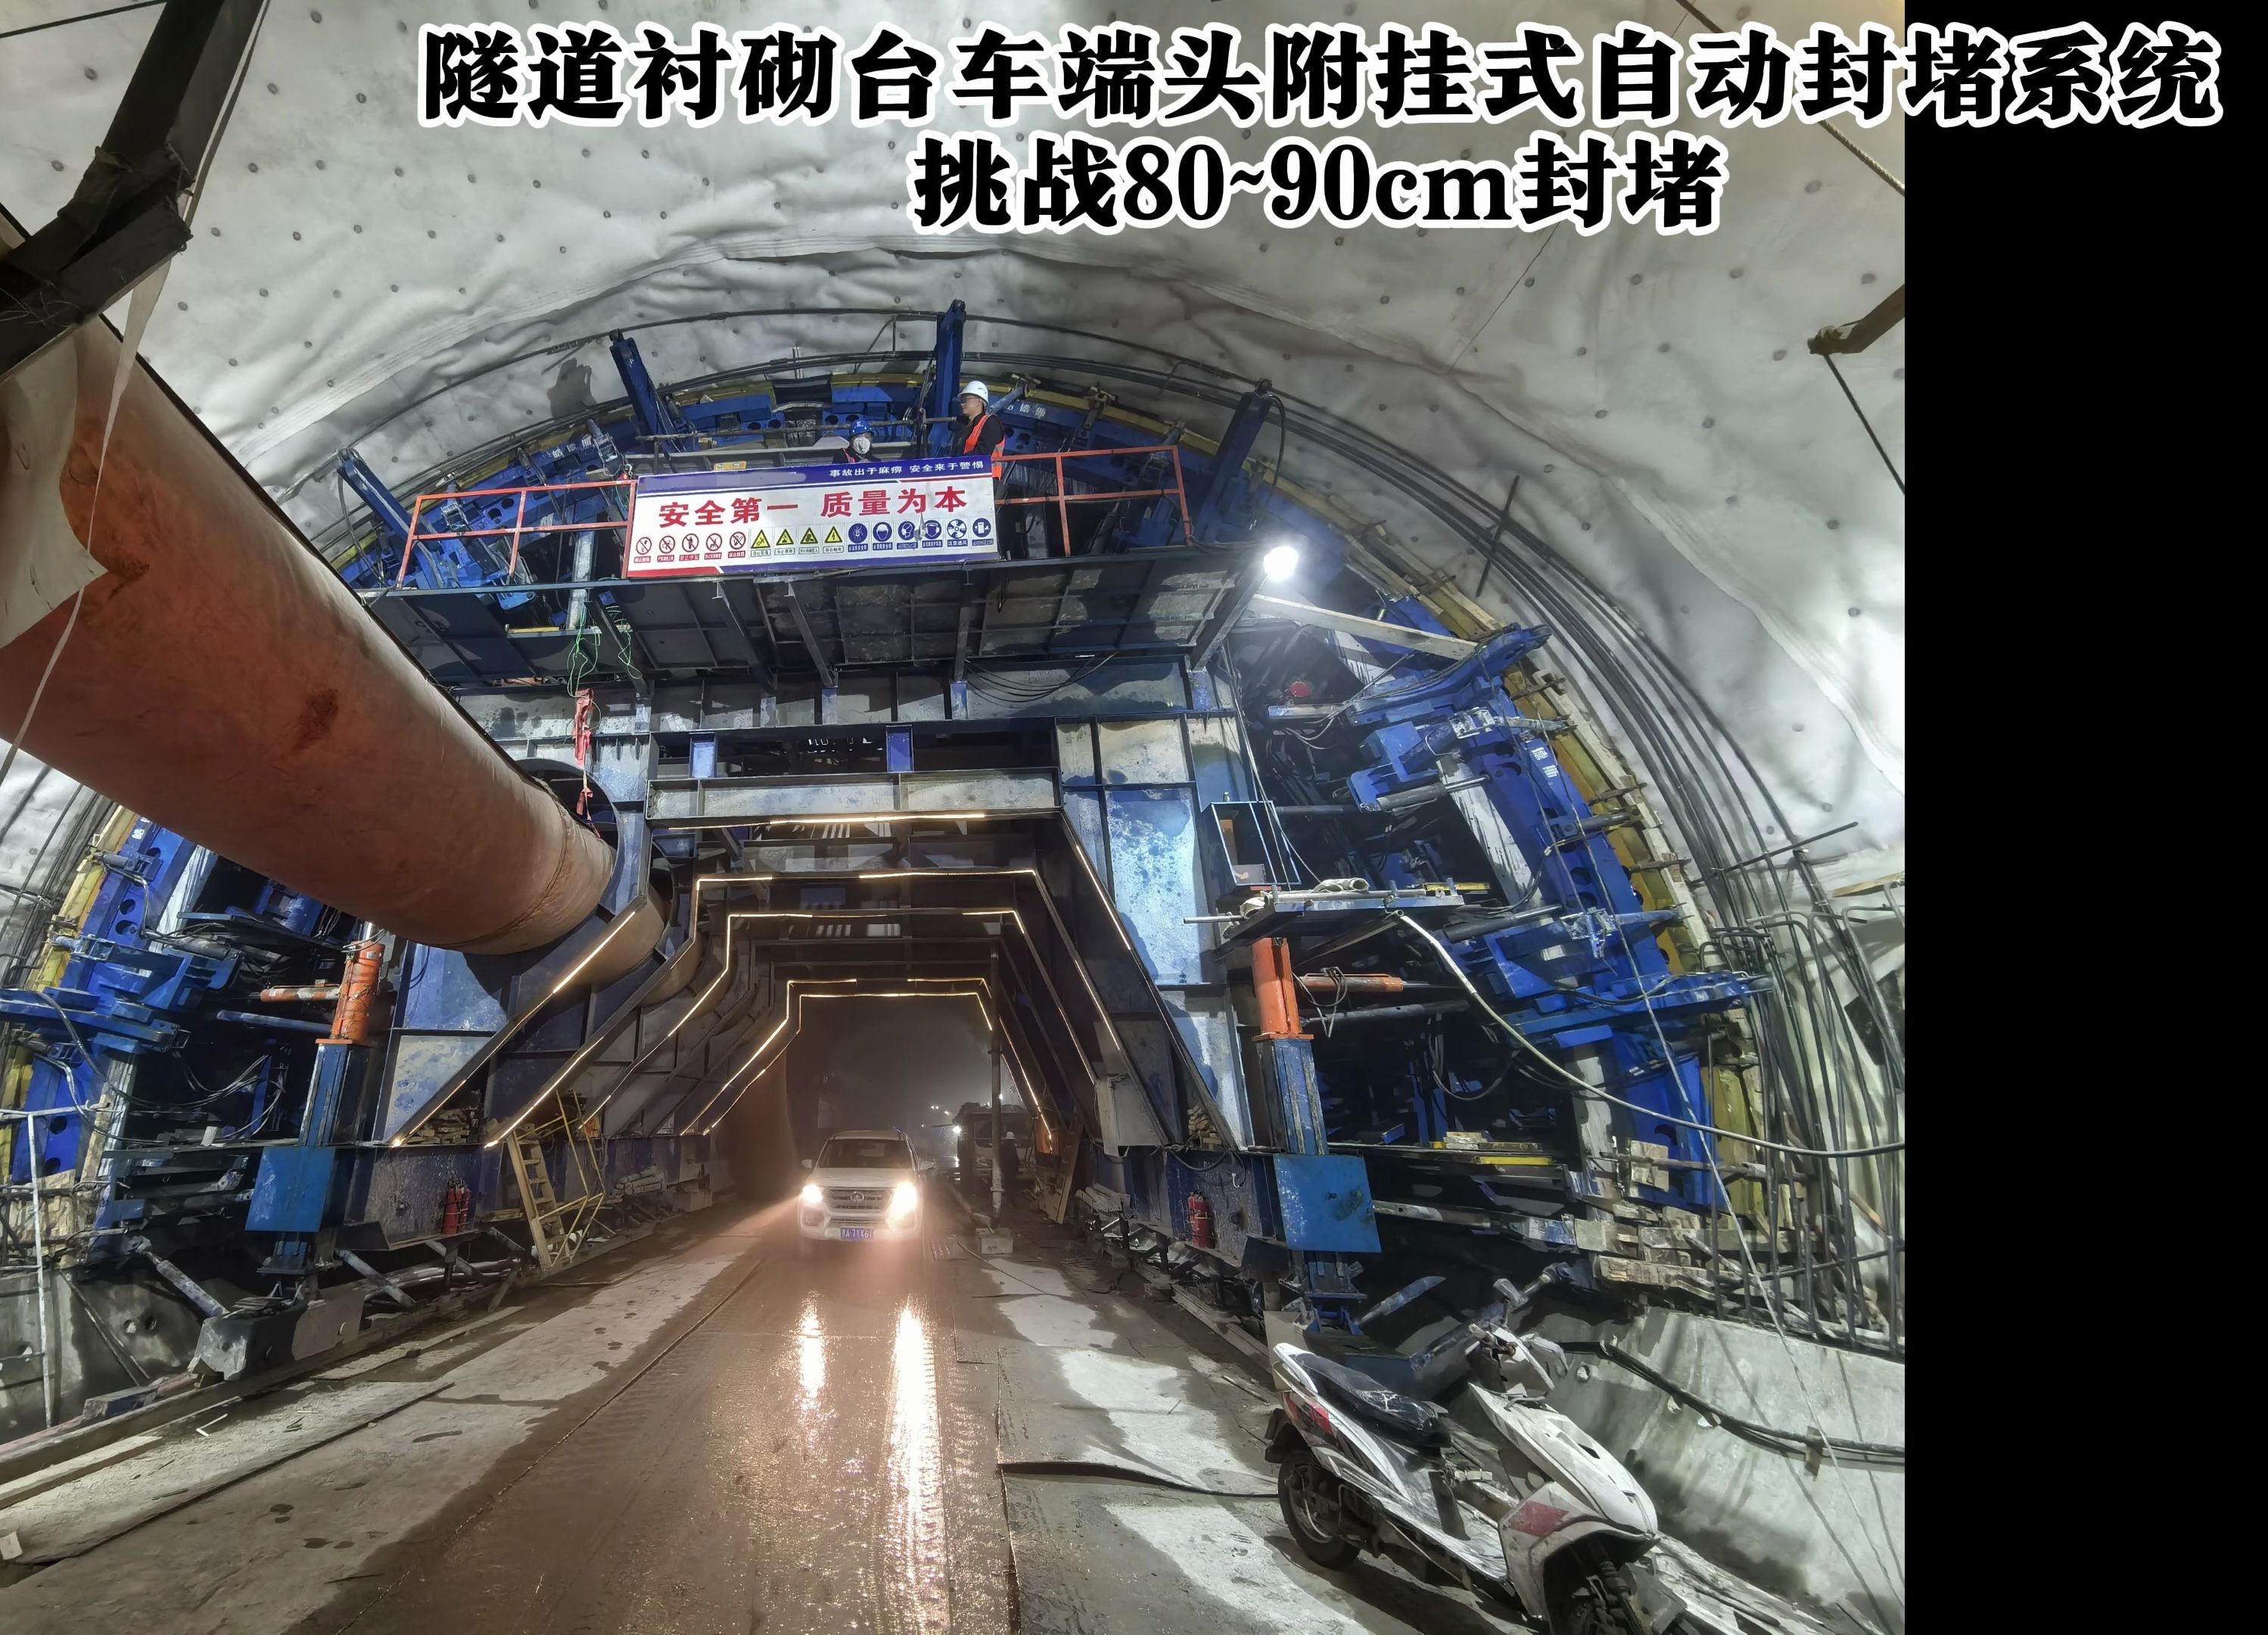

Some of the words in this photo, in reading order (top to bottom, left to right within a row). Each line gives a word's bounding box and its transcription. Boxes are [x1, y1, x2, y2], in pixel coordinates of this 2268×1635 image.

[829, 465, 903, 478] 事故出于麻痹
[909, 460, 984, 473] 安全来于警惕
[658, 497, 798, 528] 安全第一
[820, 486, 968, 519] 质量为本
